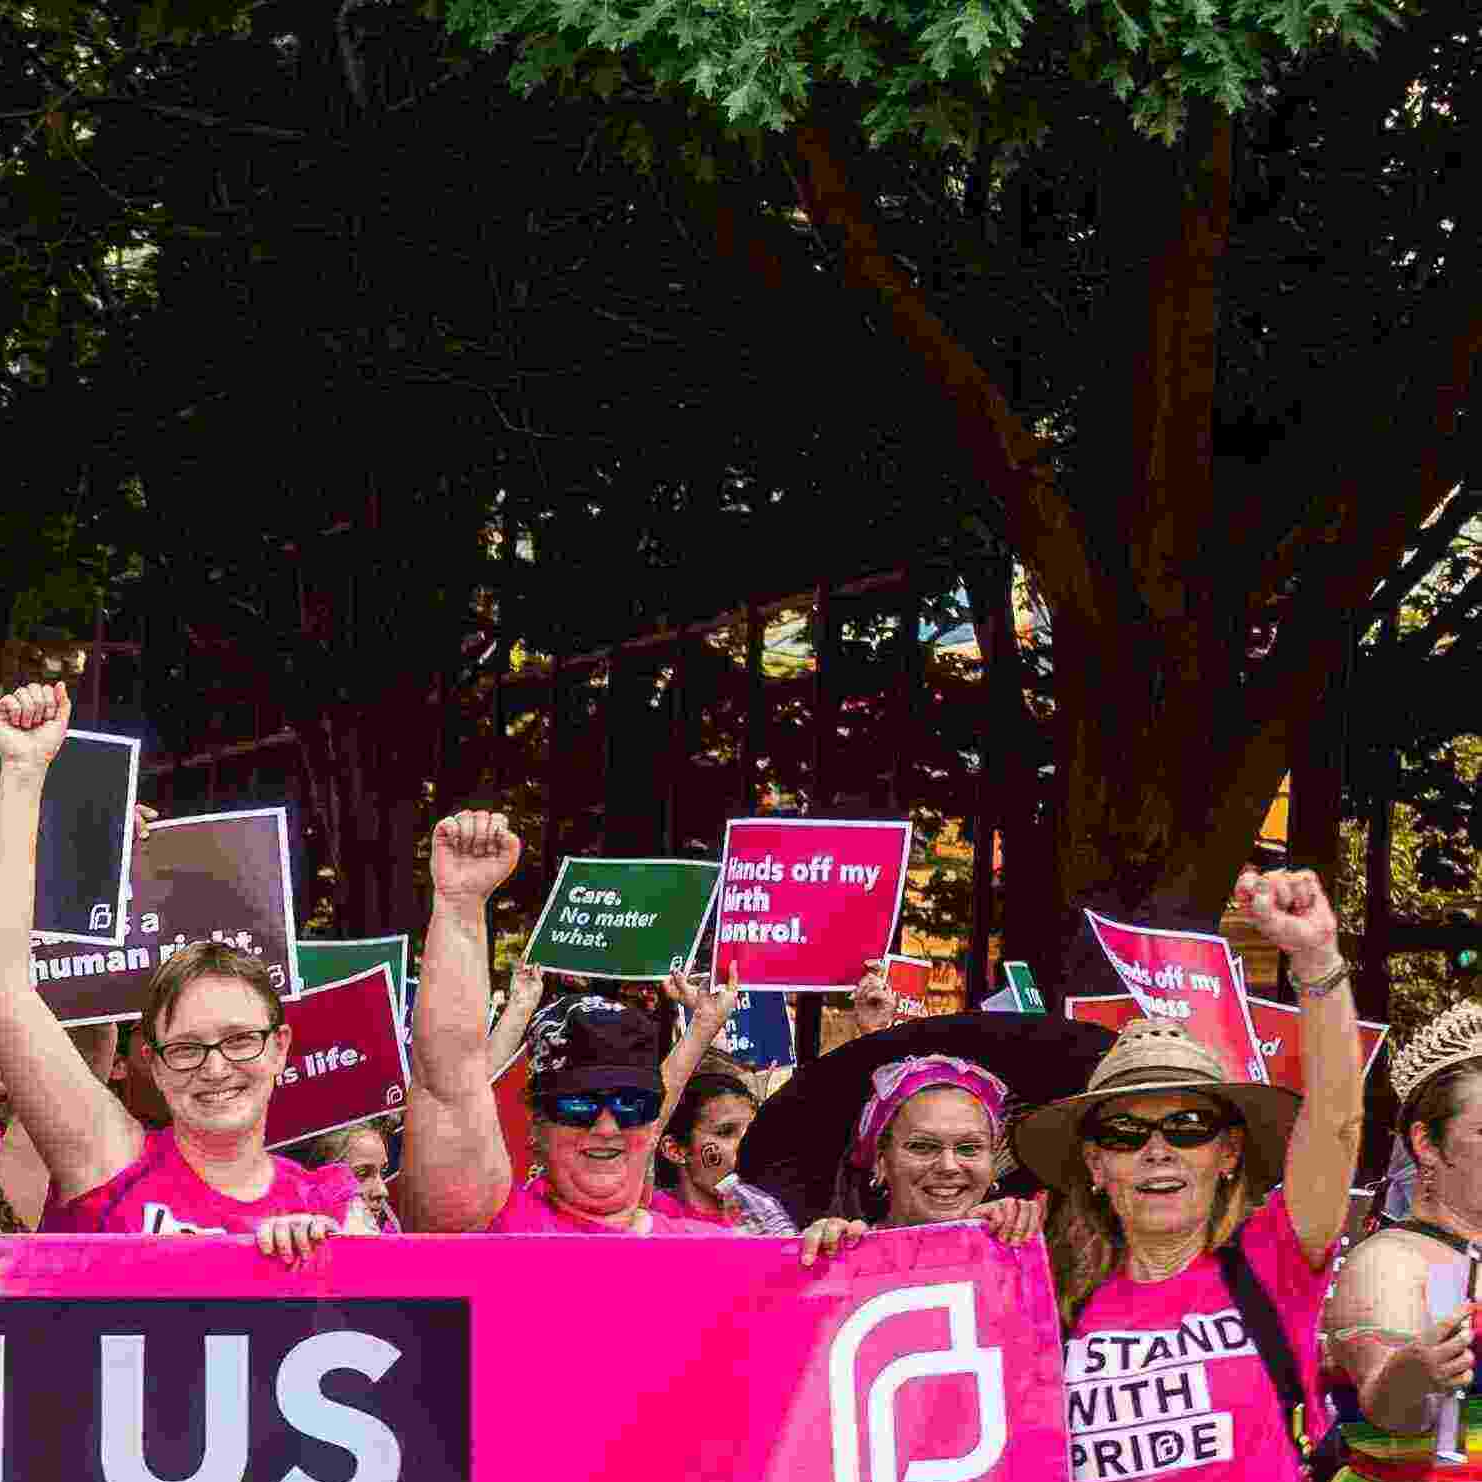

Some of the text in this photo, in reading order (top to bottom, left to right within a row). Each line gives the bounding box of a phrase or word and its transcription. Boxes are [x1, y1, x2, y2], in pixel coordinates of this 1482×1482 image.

[792, 855, 833, 882] off
[840, 864, 880, 893] my
[569, 886, 622, 907] Care.
[141, 912, 160, 933] a
[559, 907, 659, 929] No matter
[550, 929, 609, 949] what.
[305, 1047, 367, 1077] life.
[1084, 1315, 1249, 1374] STAND
